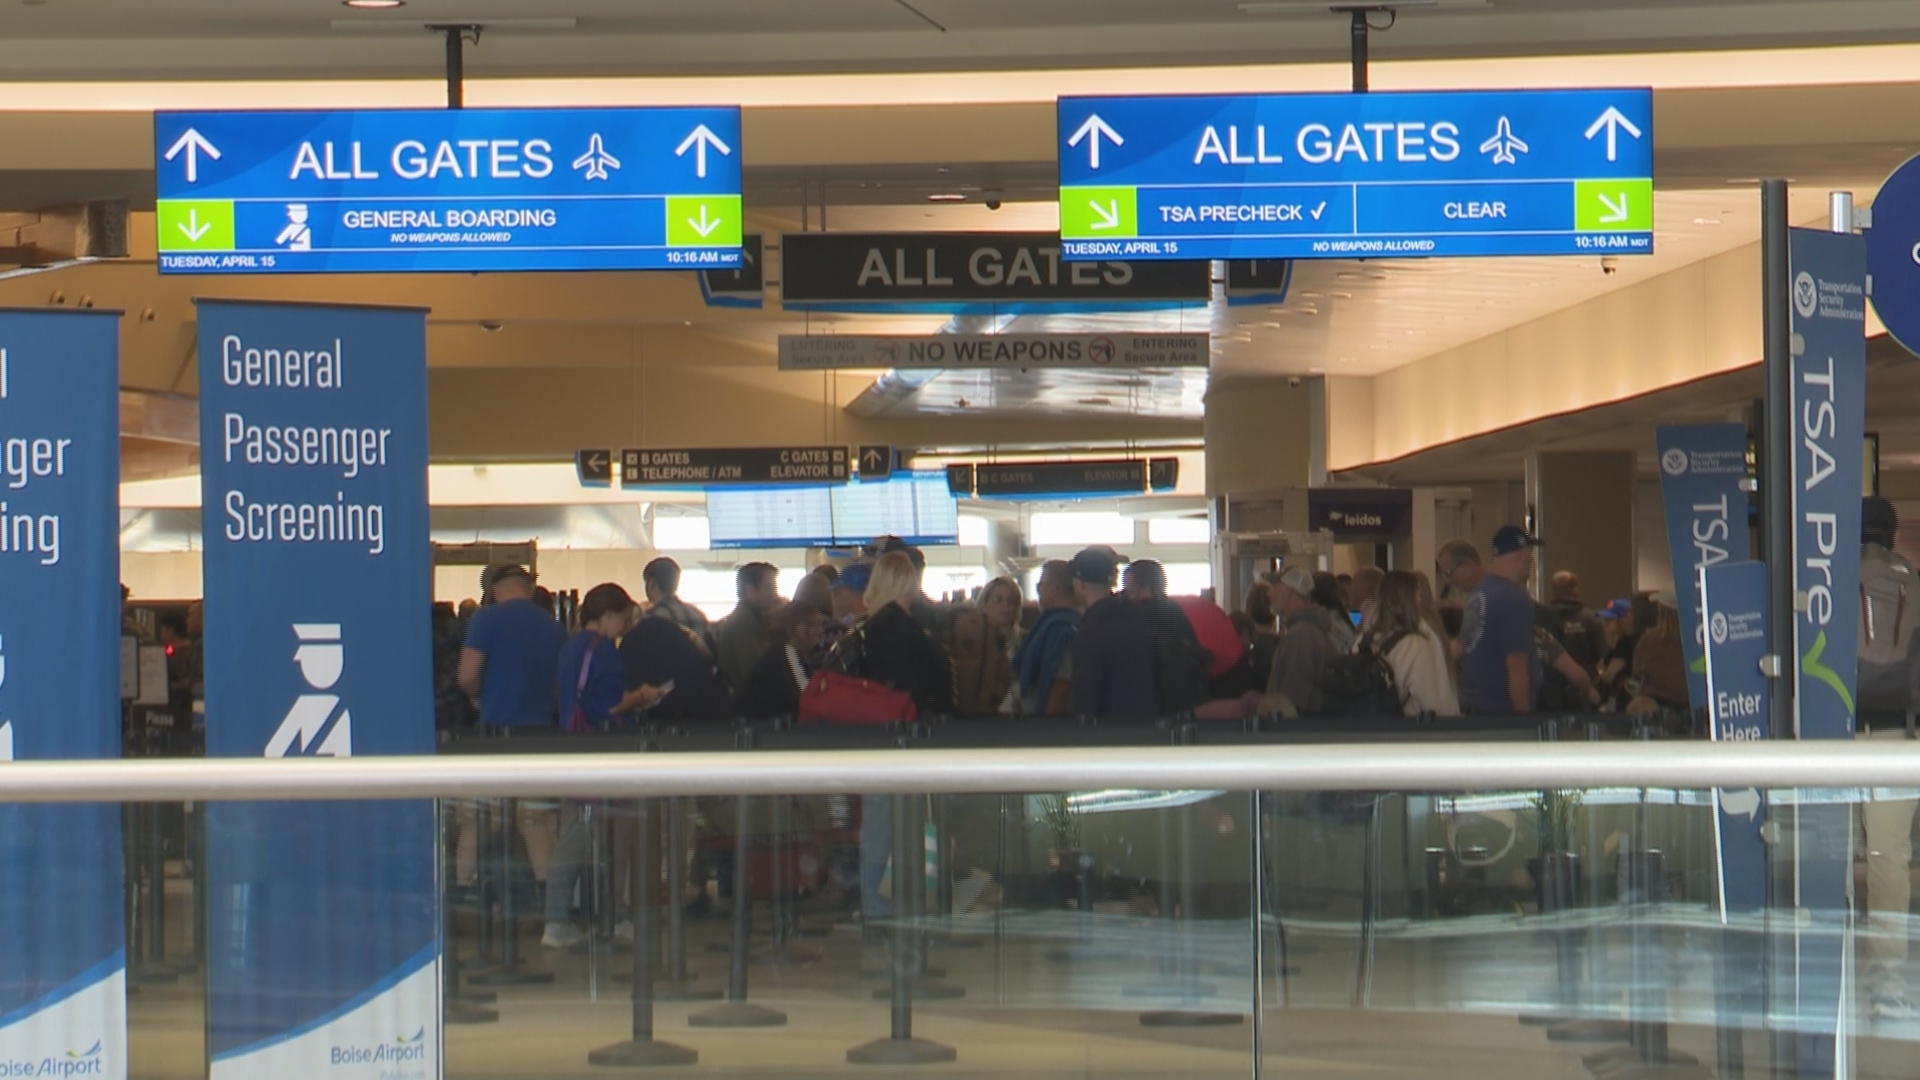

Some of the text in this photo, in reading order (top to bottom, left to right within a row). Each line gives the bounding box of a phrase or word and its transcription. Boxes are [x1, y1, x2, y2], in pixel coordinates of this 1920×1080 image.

[1194, 121, 1461, 164] ALL GATES
[289, 138, 554, 179] ALL GATES
[343, 208, 557, 228] GENERAL BOARDING
[1159, 204, 1303, 223] TSA PRECHECK
[1443, 201, 1507, 219] CLEAR
[391, 231, 512, 243] NO WEAPONS ALLOWED
[1313, 240, 1435, 252] NO WEAPONS ALLOWED
[1575, 235, 1650, 248] 10:16 AM MDT
[1063, 241, 1178, 255] TUESDAY, APRIL 15
[161, 255, 276, 269] TUESDAY, APRIL 15
[666, 251, 740, 264] 10:16 AM MDT
[856, 246, 1134, 287] ALL GATES
[790, 339, 856, 352] ENTERING
[908, 339, 1082, 362] NO WEAPONS
[1132, 337, 1198, 349] ENTERING
[222, 334, 343, 389] General
[1124, 351, 1197, 364] Secure Area
[223, 412, 392, 479] Passenger
[0, 437, 72, 489] ger
[641, 451, 691, 466] B GATES
[780, 449, 830, 464] C GATES
[641, 466, 742, 480] TELEPHONE / ATM
[770, 465, 830, 479] ELEVATOR
[1001, 472, 1034, 485] GATES
[1084, 470, 1128, 482] ELEVATOR
[1803, 356, 1838, 626] TSA Pre
[225, 489, 385, 555] Screening
[1344, 512, 1383, 526] leidos
[1692, 493, 1730, 572] TSA
[1717, 691, 1762, 719] Enter
[1721, 722, 1761, 741] Here
[331, 1042, 425, 1065] Boise Airport
[36, 1056, 102, 1080] Airport
